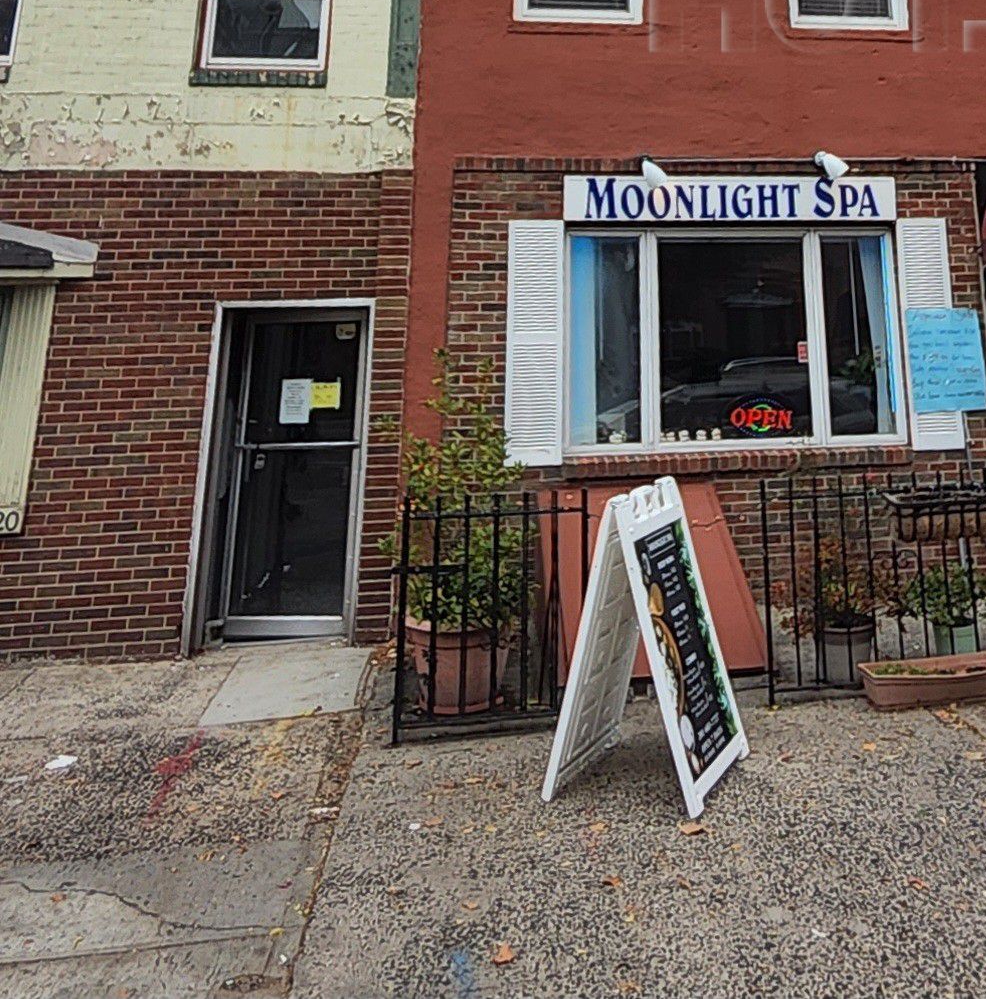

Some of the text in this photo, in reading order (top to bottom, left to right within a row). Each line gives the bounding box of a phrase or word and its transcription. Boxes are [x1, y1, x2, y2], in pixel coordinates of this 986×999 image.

[584, 177, 880, 220] MOONLIGHT SPA
[730, 407, 793, 430] OPEN
